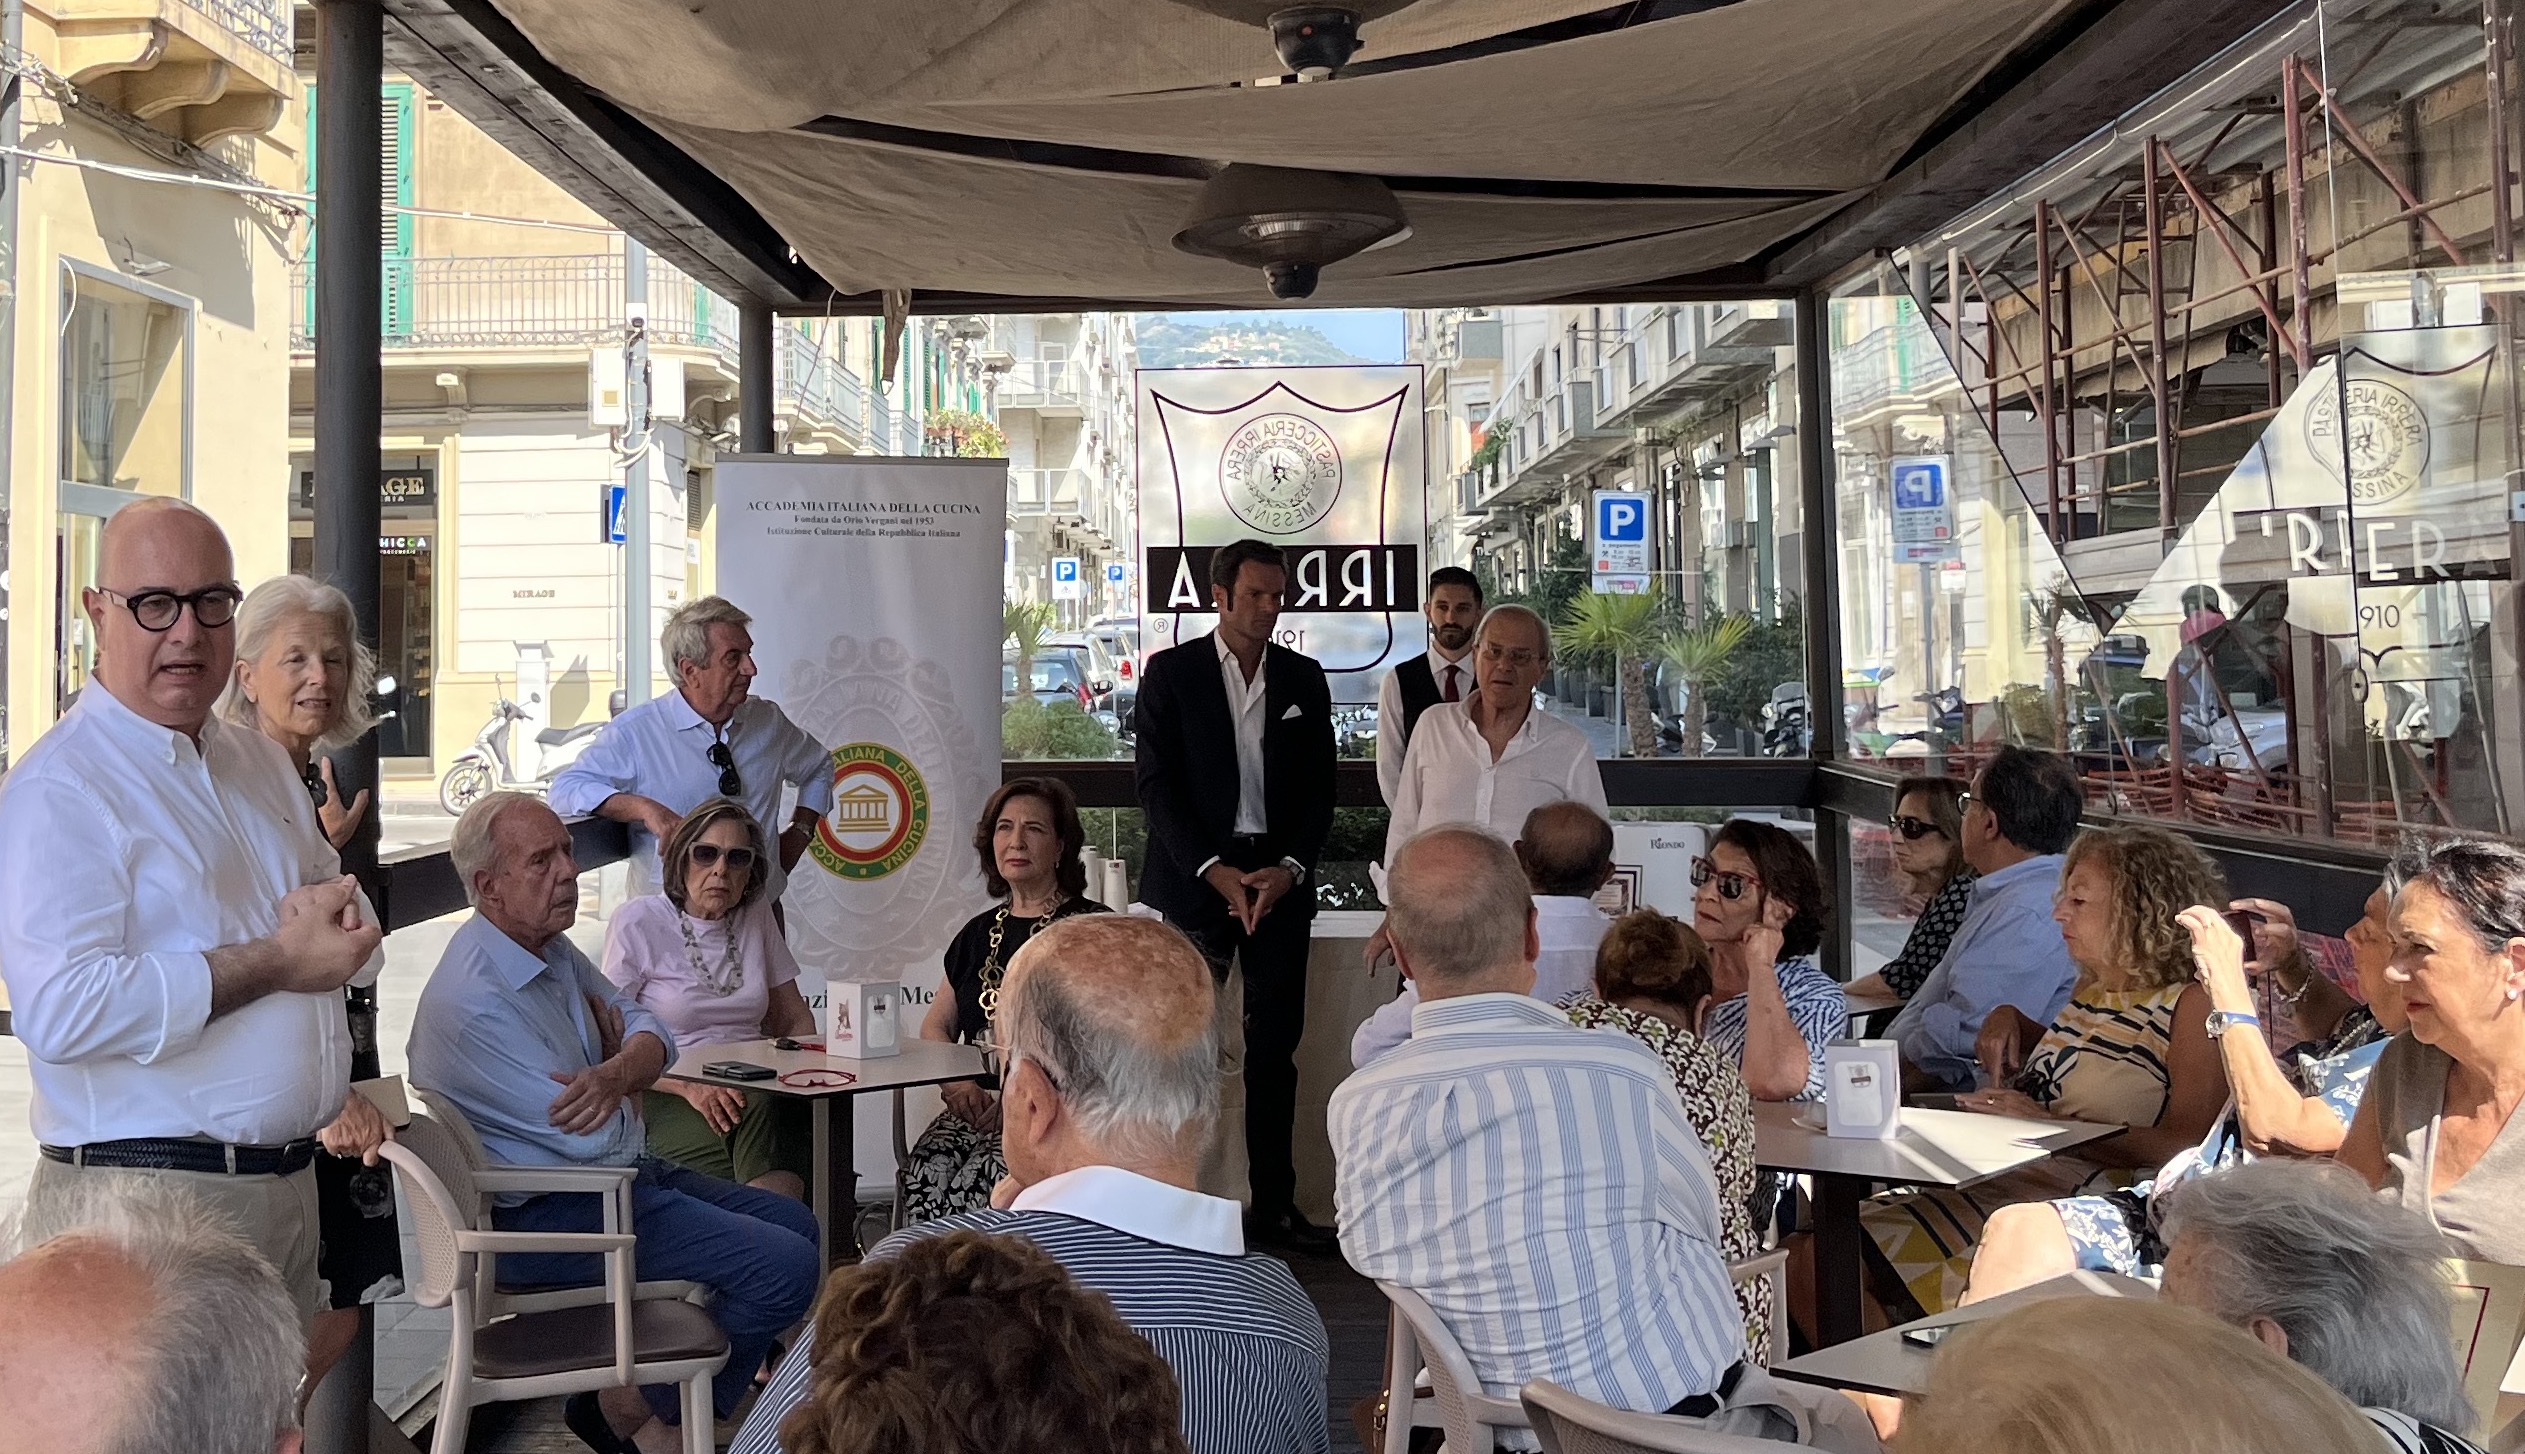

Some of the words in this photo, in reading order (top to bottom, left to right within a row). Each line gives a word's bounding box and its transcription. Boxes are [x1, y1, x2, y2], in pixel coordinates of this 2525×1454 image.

[2312, 386, 2377, 437] PASTICERIA
[2352, 470, 2408, 498] SSINA
[746, 501, 825, 512] ACCADEMIA
[827, 502, 886, 513] ITALIANA
[889, 502, 930, 513] DELLA
[933, 503, 981, 514] CUCINA
[794, 515, 829, 523] Fondata
[843, 516, 863, 524] Orio
[865, 516, 899, 525] Vergani
[1610, 504, 1635, 536] P
[767, 527, 813, 535] Istituzione
[814, 527, 854, 536] Culturale
[855, 528, 876, 536] della
[878, 529, 926, 538] Repubblica
[928, 530, 961, 538] Italiana
[1060, 563, 1073, 580] P
[1111, 567, 1121, 579] P
[513, 590, 555, 598] MIRAGE
[2360, 604, 2400, 629] 910
[833, 746, 886, 768] ALIANA
[895, 761, 926, 810] DELLA
[881, 819, 925, 873] CUCINA
